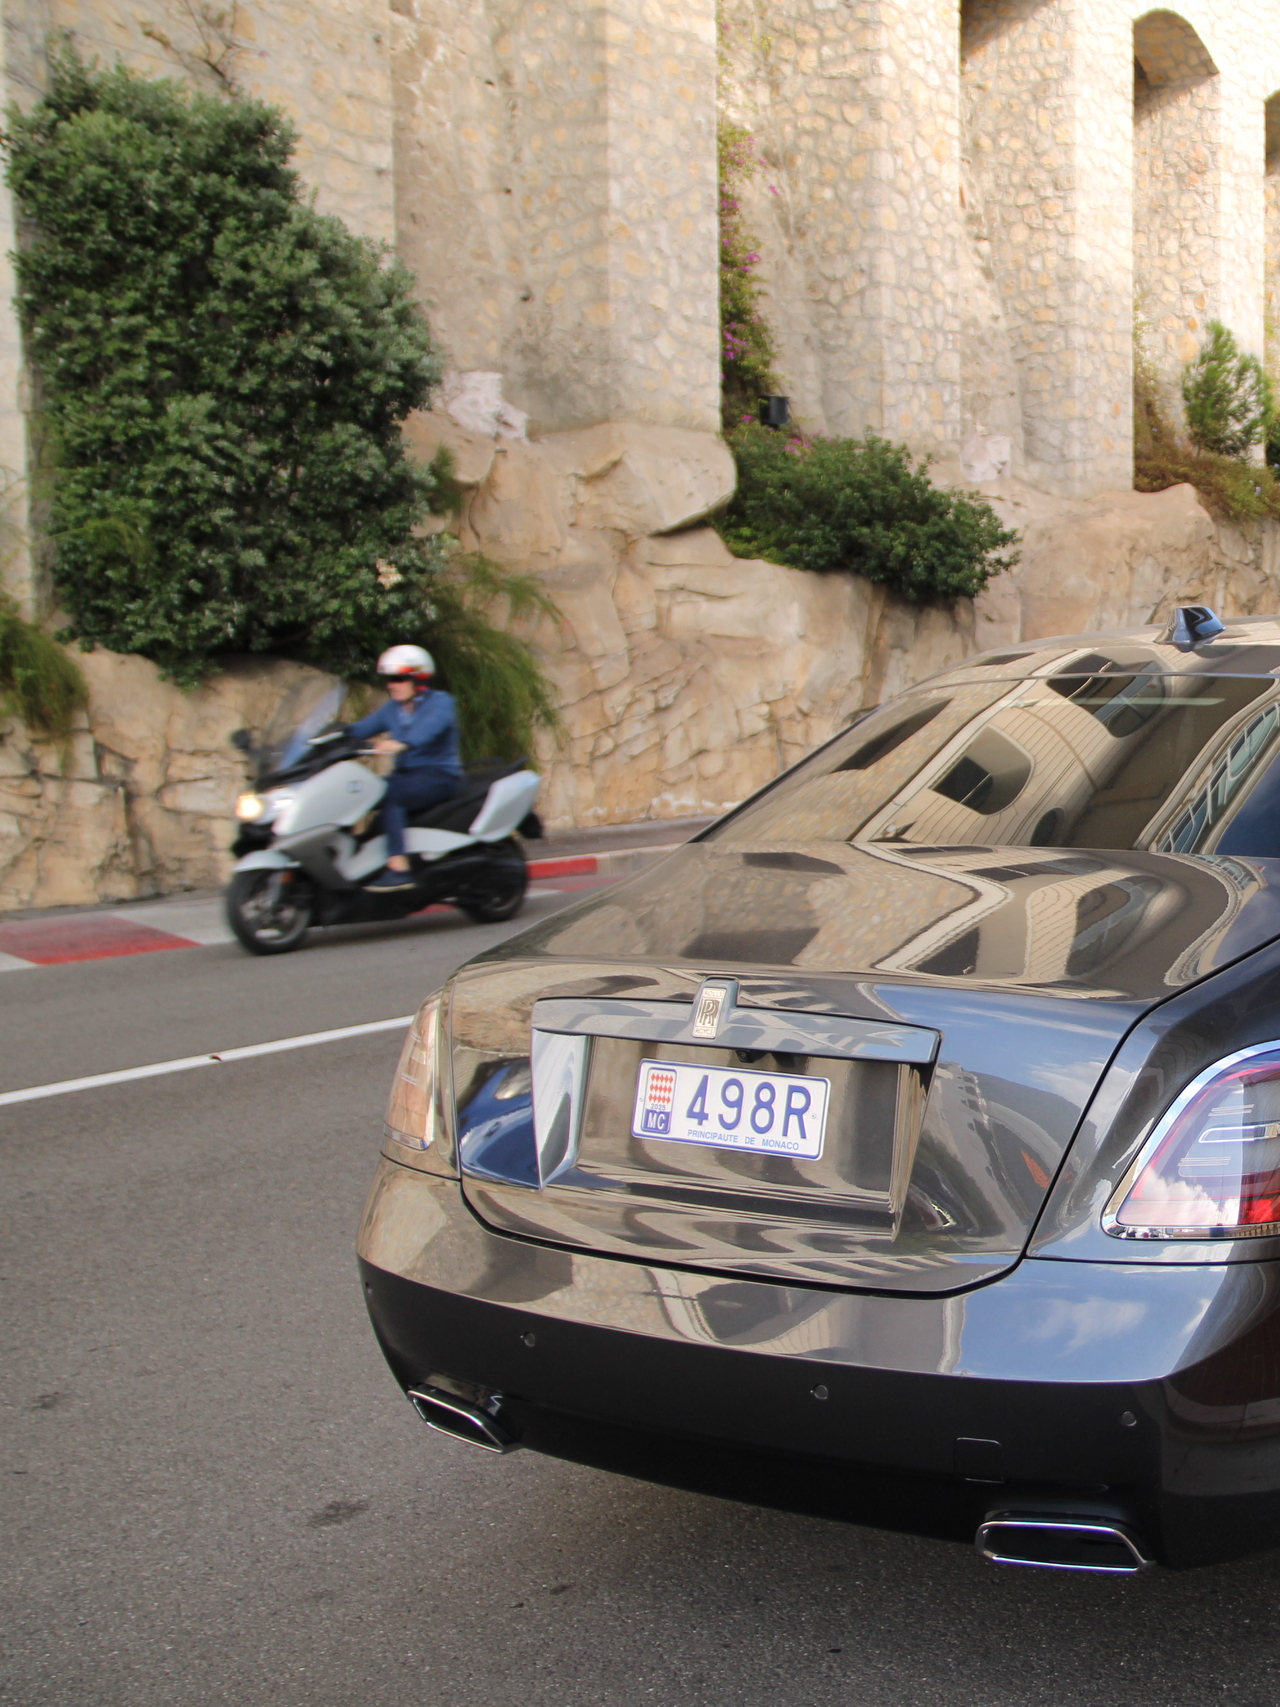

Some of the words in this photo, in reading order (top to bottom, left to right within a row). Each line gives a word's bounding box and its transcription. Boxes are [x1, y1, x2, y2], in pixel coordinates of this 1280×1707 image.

[650, 1103, 666, 1111] 2025
[686, 1075, 811, 1139] 498R
[647, 1112, 665, 1130] MC
[687, 1129, 738, 1143] PRINCIPAUTE
[744, 1136, 755, 1145] DE
[761, 1138, 799, 1151] MONACO
